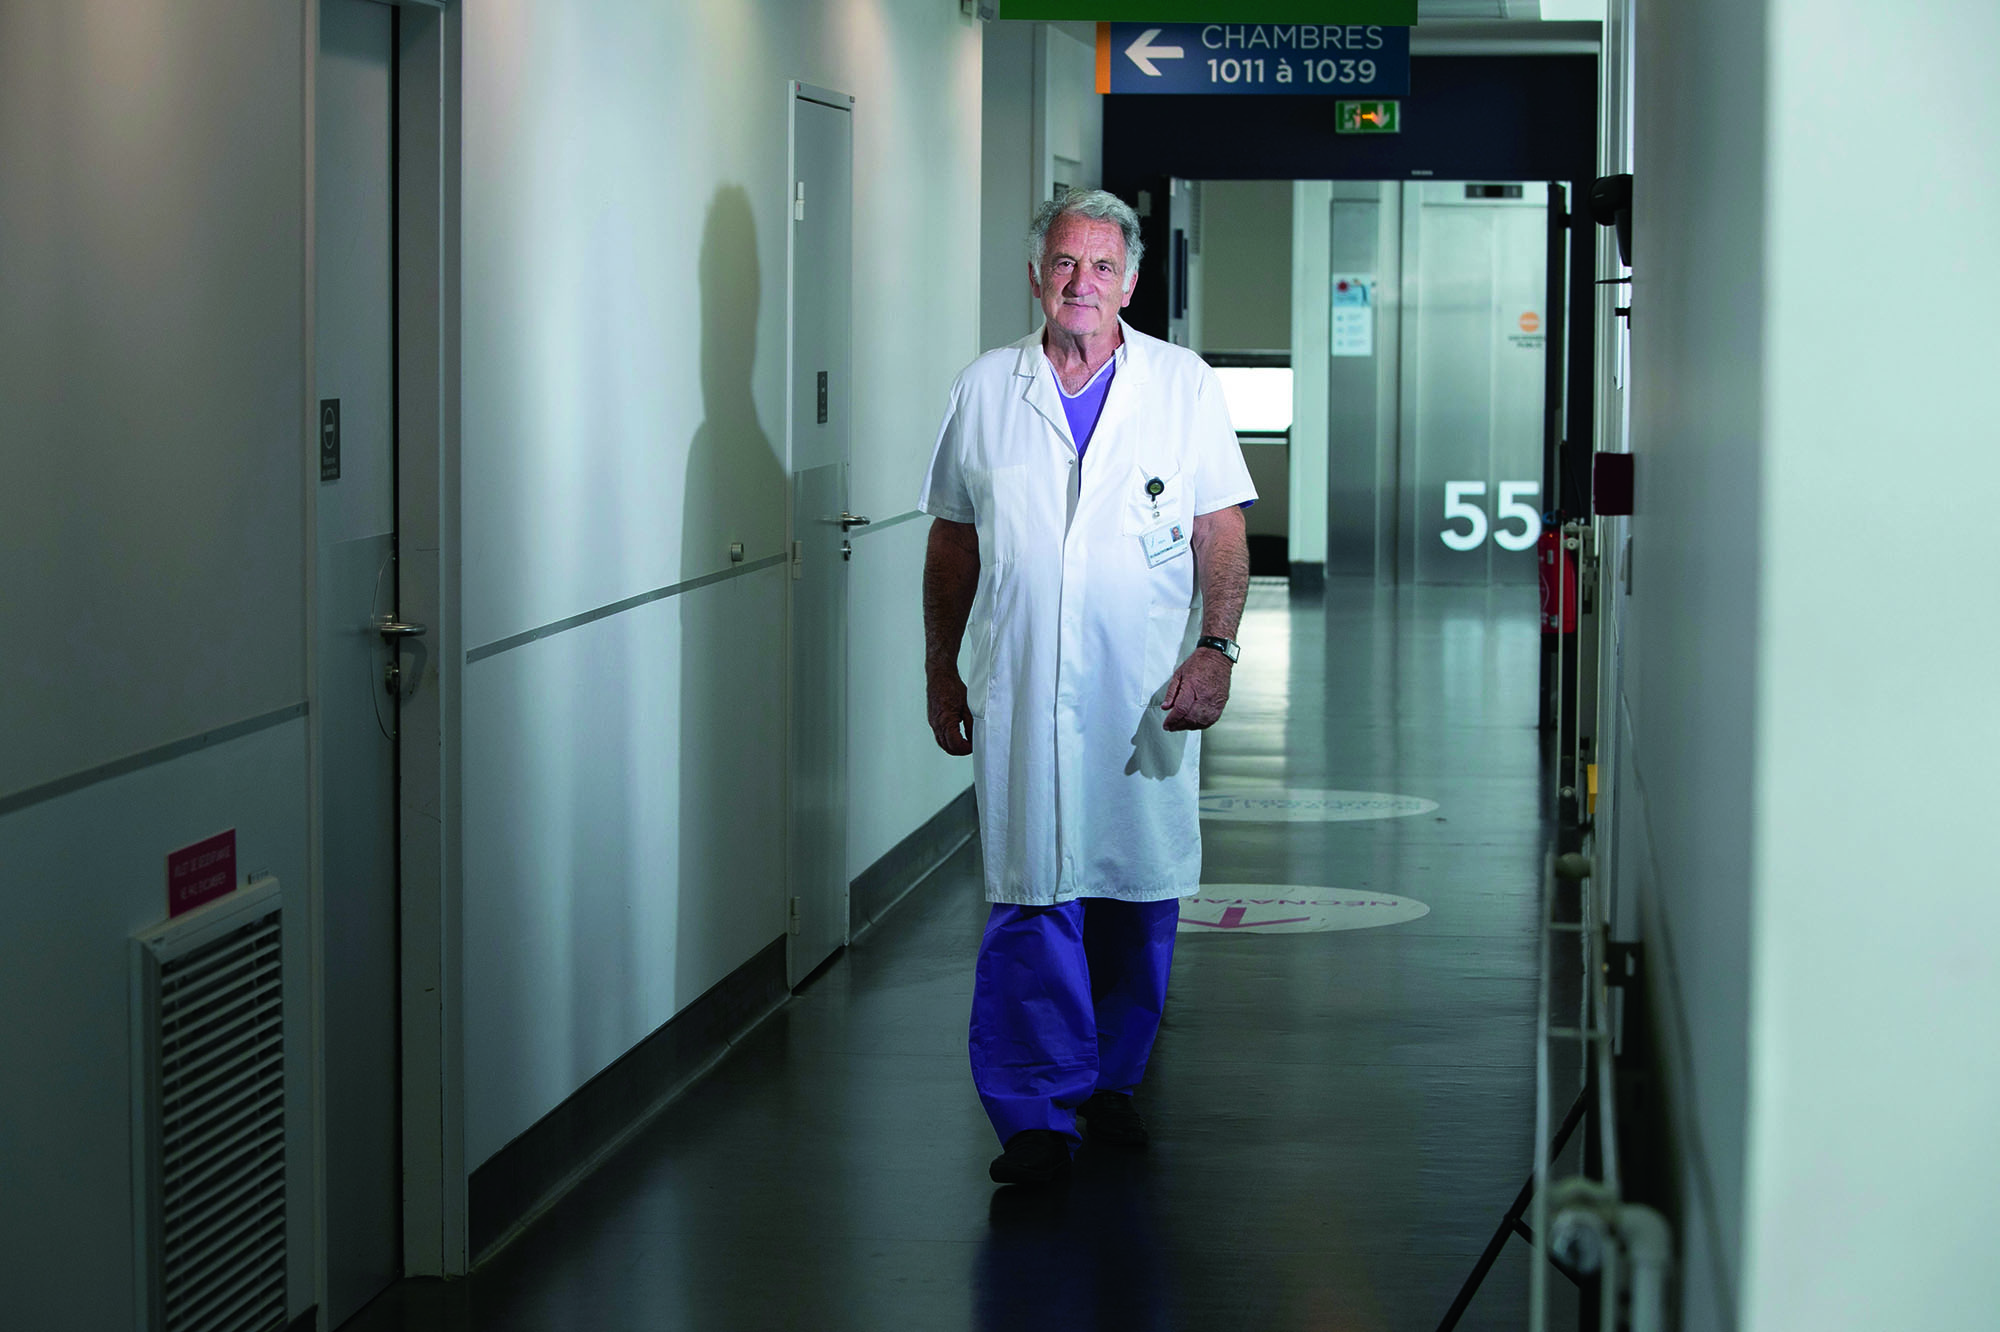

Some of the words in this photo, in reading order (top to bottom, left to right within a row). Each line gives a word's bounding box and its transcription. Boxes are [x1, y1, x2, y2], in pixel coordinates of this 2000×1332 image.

[1201, 25, 1384, 50] CHAMBRES
[1207, 58, 1265, 83] 1011
[1276, 57, 1293, 83] à
[1303, 59, 1377, 84] 1039
[1440, 480, 1542, 552] 55
